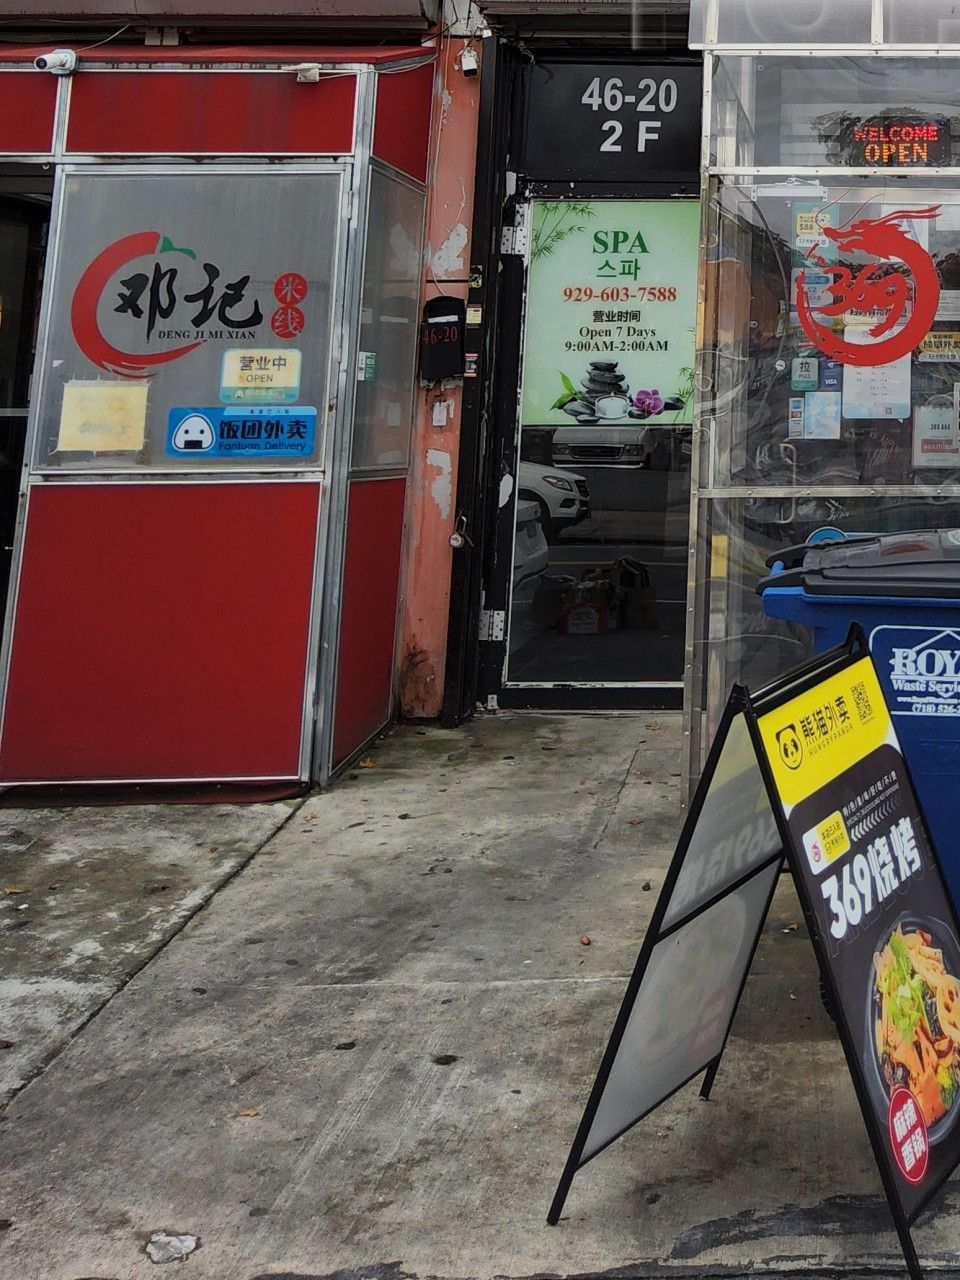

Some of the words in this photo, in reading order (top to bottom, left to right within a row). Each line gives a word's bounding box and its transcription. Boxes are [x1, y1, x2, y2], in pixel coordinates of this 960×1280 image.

[582, 77, 678, 113] 46-20
[600, 121, 622, 152] 2
[638, 121, 662, 152] F
[854, 125, 938, 142] WELCOME
[865, 144, 928, 163] OPEN
[593, 230, 650, 255] SPA
[596, 258, 641, 281] 스파
[112, 261, 263, 343] 邓记
[563, 286, 677, 303] 929-603-7588
[593, 309, 641, 323] 营业时间
[157, 329, 191, 339] DENG
[194, 330, 206, 340] JI
[208, 330, 224, 340] MI
[226, 331, 256, 340] XIAN
[579, 326, 612, 340] Open
[616, 326, 623, 338] 7
[626, 326, 656, 341] Days
[564, 340, 670, 353] 9:00AM-2:00AM
[240, 356, 287, 372] 营业中
[246, 374, 274, 383] OPEN
[219, 419, 308, 440] 饭团外卖
[219, 441, 260, 451] Fantuan
[265, 442, 306, 452] Delivery
[892, 680, 926, 692] Waste
[912, 703, 936, 713] (718)
[800, 695, 850, 740] 熊猫外卖
